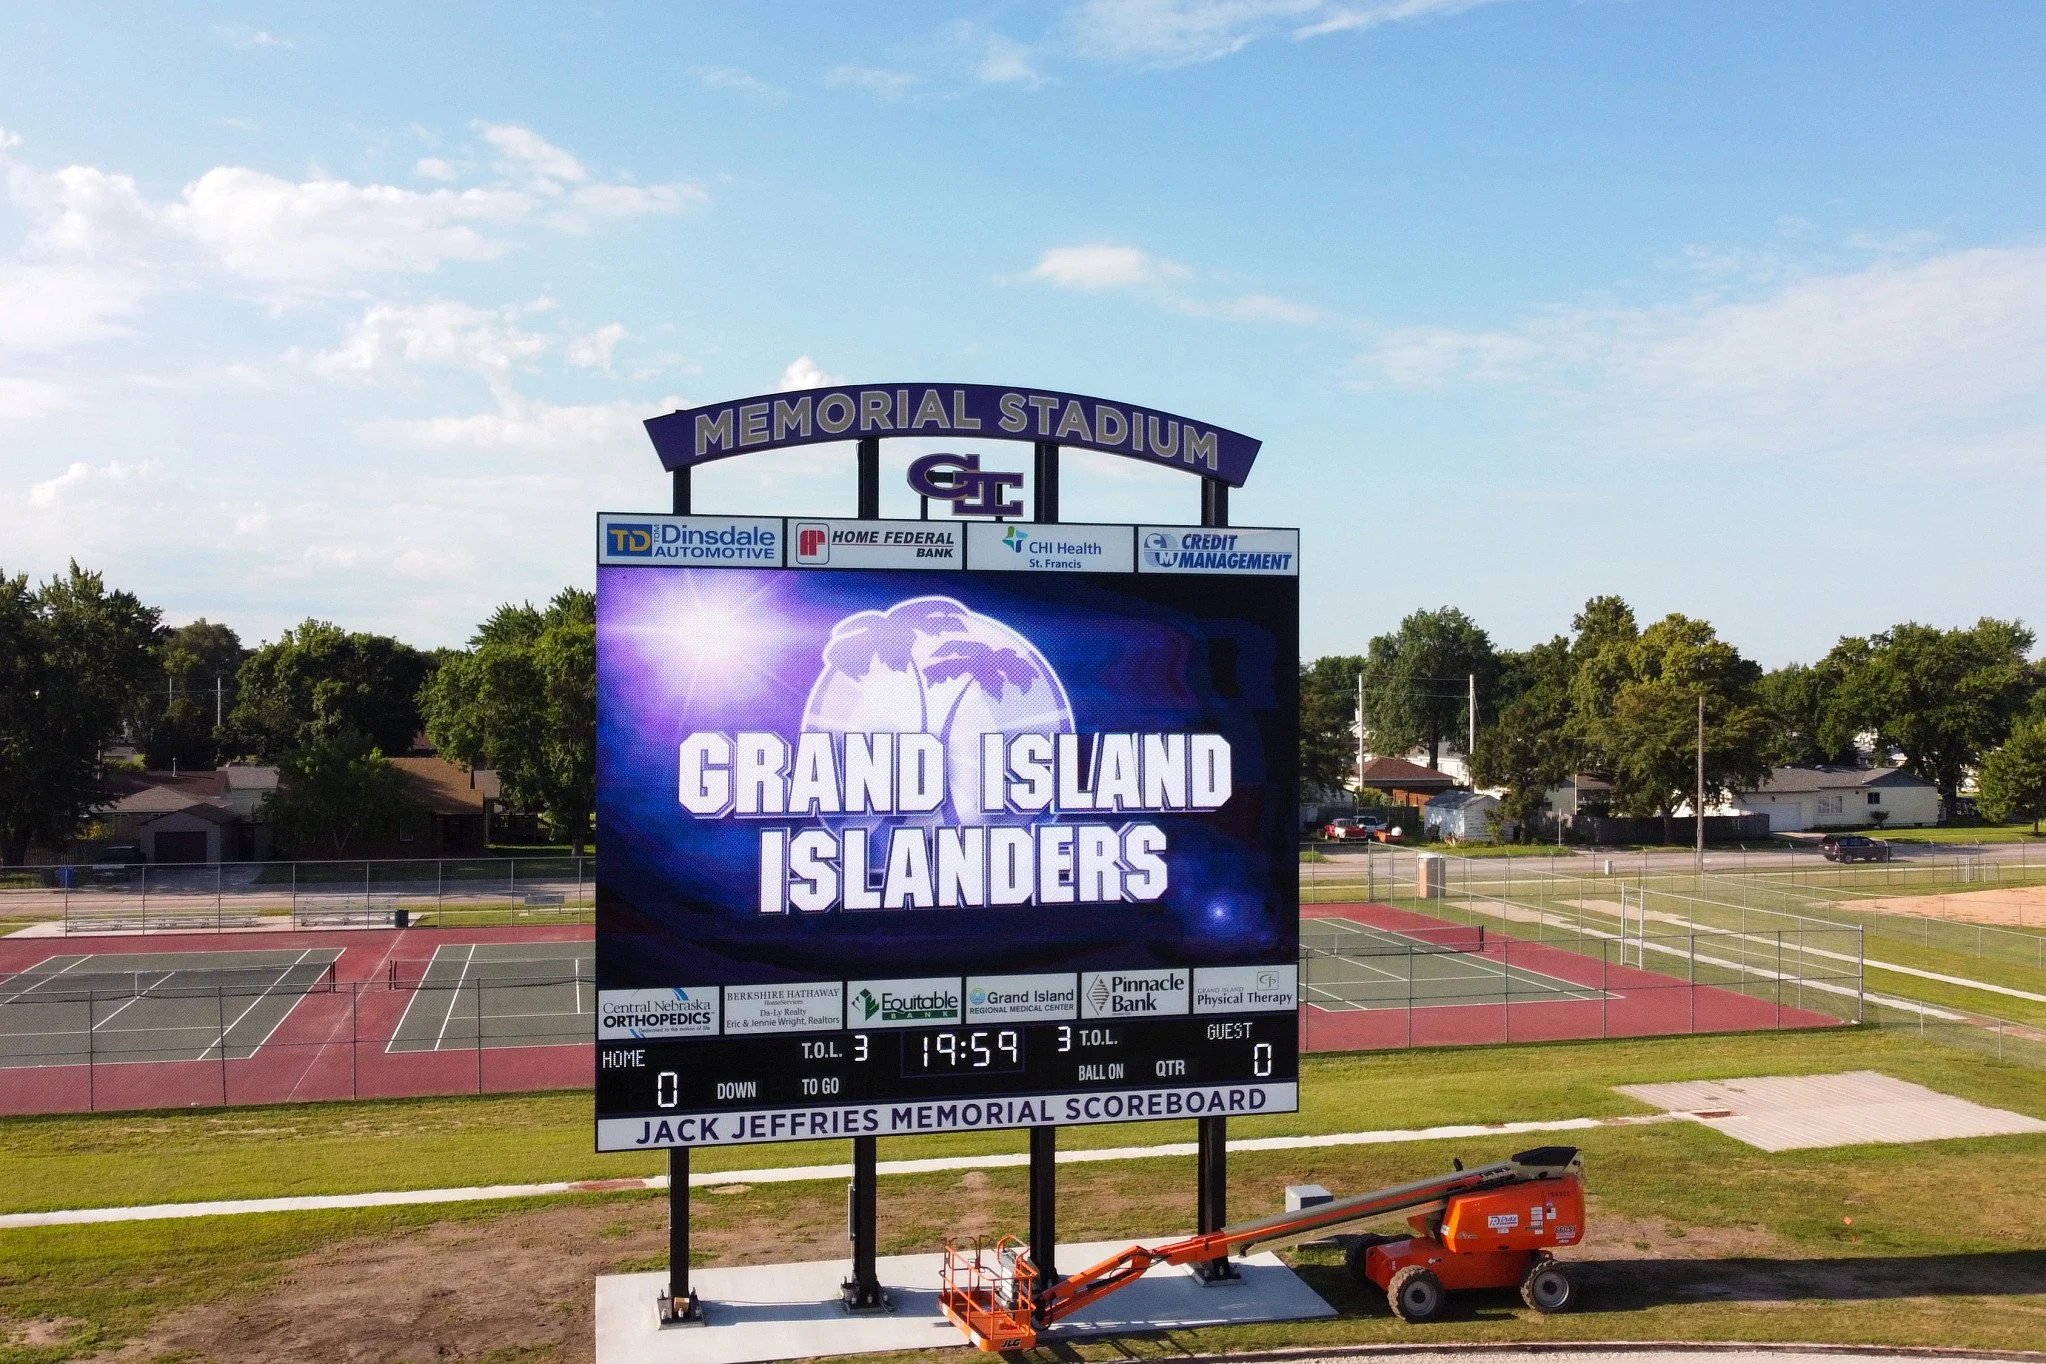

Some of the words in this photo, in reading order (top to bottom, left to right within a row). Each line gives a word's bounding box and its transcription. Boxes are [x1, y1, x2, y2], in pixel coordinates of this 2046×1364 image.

[695, 389, 982, 456] MEMORIAL
[998, 393, 1219, 471] STADIUM
[608, 529, 652, 553] TD
[653, 524, 661, 543] TOM
[661, 524, 776, 547] Dinsdale
[831, 530, 880, 544] HOME
[883, 531, 955, 545] FEDERAL
[1181, 533, 1238, 551] CREDIT
[653, 546, 775, 560] AUTOMOTIVE
[916, 548, 954, 558] BANK
[1029, 541, 1053, 554] CHI
[1057, 541, 1102, 555] Health
[1029, 558, 1043, 569] St.
[1045, 559, 1082, 569] Francis
[1178, 552, 1292, 571] MANAGEMENT
[679, 731, 946, 818] GRAND
[980, 731, 1233, 815] ISLAND
[758, 821, 1169, 915] ISLANDERS
[1111, 973, 1185, 993] Pinnacle
[726, 990, 784, 1001] BERKSHIRE
[787, 988, 839, 998] HATHAWAY
[882, 990, 958, 1014] Equitable
[987, 990, 1029, 1005] Grand
[1034, 989, 1074, 1002] Island
[1112, 992, 1157, 1013] Bank
[1197, 992, 1243, 1008] Physical
[1246, 991, 1293, 1006] Therapy
[602, 1000, 651, 1014] Central
[654, 998, 711, 1012] Nebraska
[784, 1007, 807, 1016] Realty
[890, 1011, 948, 1019] BANK
[969, 1006, 1008, 1015] REGIONAL
[1010, 1004, 1042, 1013] MEDICAL
[1044, 1003, 1074, 1012] CENTER
[603, 1012, 711, 1029] ORTHOPEDICS
[726, 1019, 741, 1029] Eric
[742, 1019, 749, 1028] &
[749, 1018, 776, 1028] Jennie
[778, 1017, 807, 1028] Wright,
[808, 1015, 840, 1025] Realtors
[1057, 1026, 1071, 1052] 3
[1079, 1029, 1118, 1047] T.O.L.
[1207, 1022, 1253, 1040] GUEST
[801, 1041, 843, 1060] T.O.L.
[854, 1034, 868, 1061] 3
[923, 1031, 1017, 1067] 19:59
[602, 1049, 646, 1069] HOME
[1155, 1059, 1186, 1077] QTR
[1253, 1043, 1272, 1076] 0
[1078, 1064, 1106, 1081] BALL
[1108, 1063, 1124, 1080] ON
[657, 1071, 678, 1108] 0
[717, 1081, 757, 1100] DOWN
[802, 1078, 818, 1095] TO
[821, 1077, 840, 1094] GO
[635, 1116, 720, 1145] JACK
[731, 1108, 879, 1140] JEFFRIES
[891, 1099, 1055, 1130] MEMORIAL
[1065, 1087, 1266, 1120] SCOREBOARD
[1001, 1338, 1022, 1348] JLG
